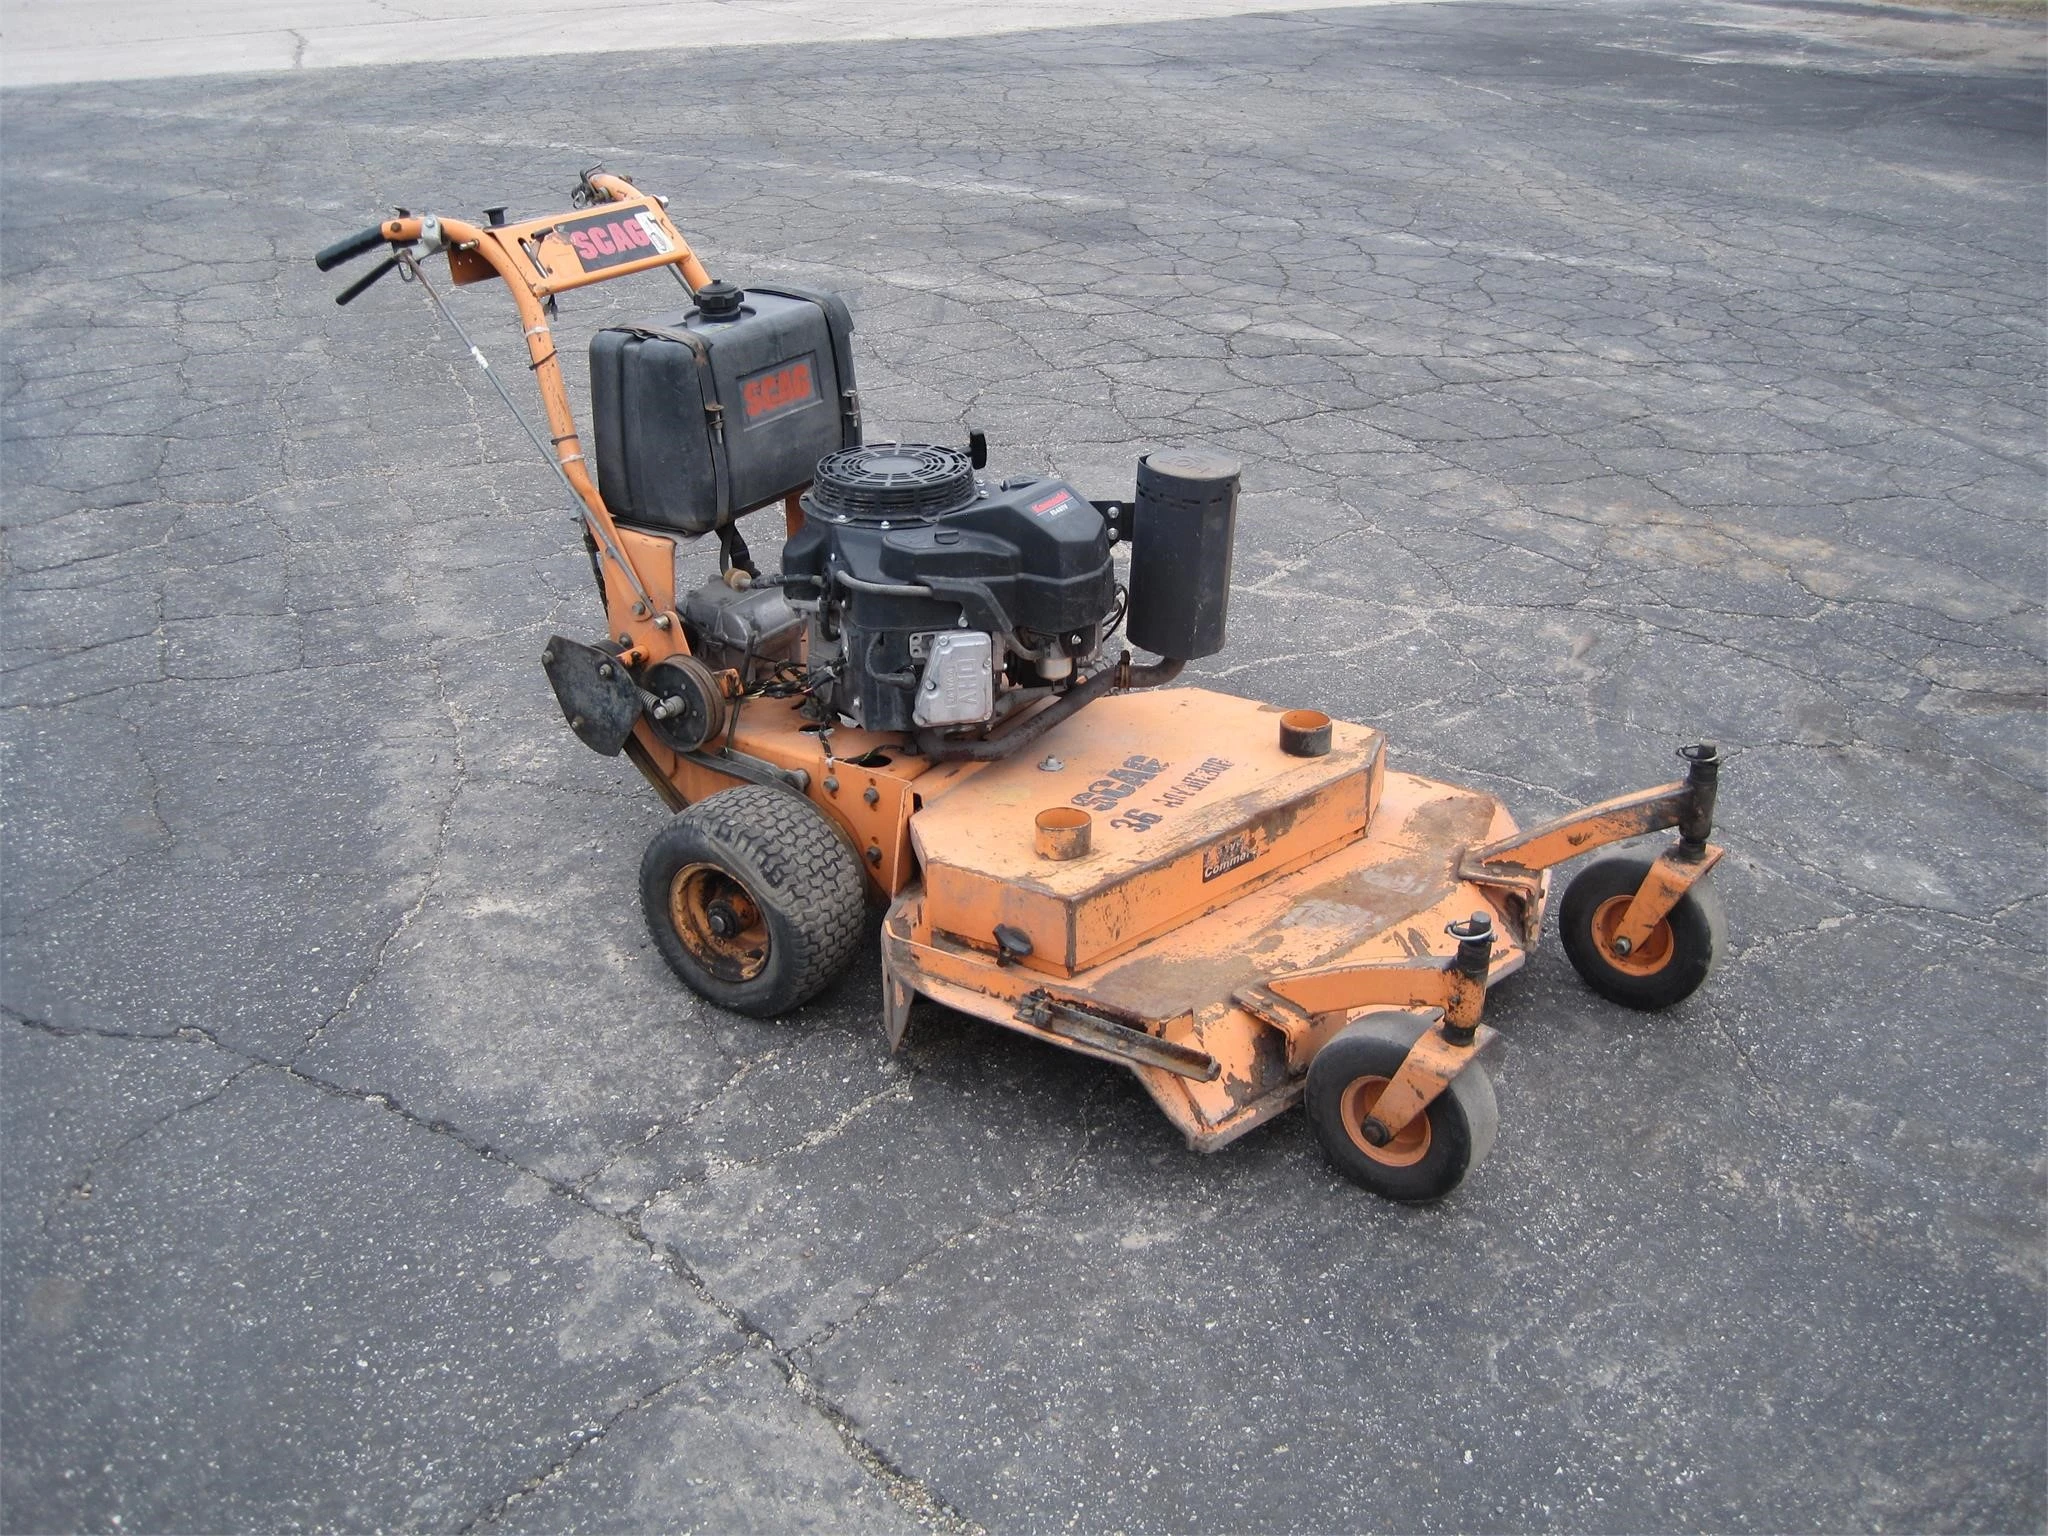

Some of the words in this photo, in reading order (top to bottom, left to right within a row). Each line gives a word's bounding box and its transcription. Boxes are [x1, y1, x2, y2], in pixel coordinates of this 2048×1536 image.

[570, 218, 650, 259] SCAG
[743, 363, 810, 417] SCAG
[1071, 755, 1170, 811] SCAG
[1110, 808, 1164, 833] 36
